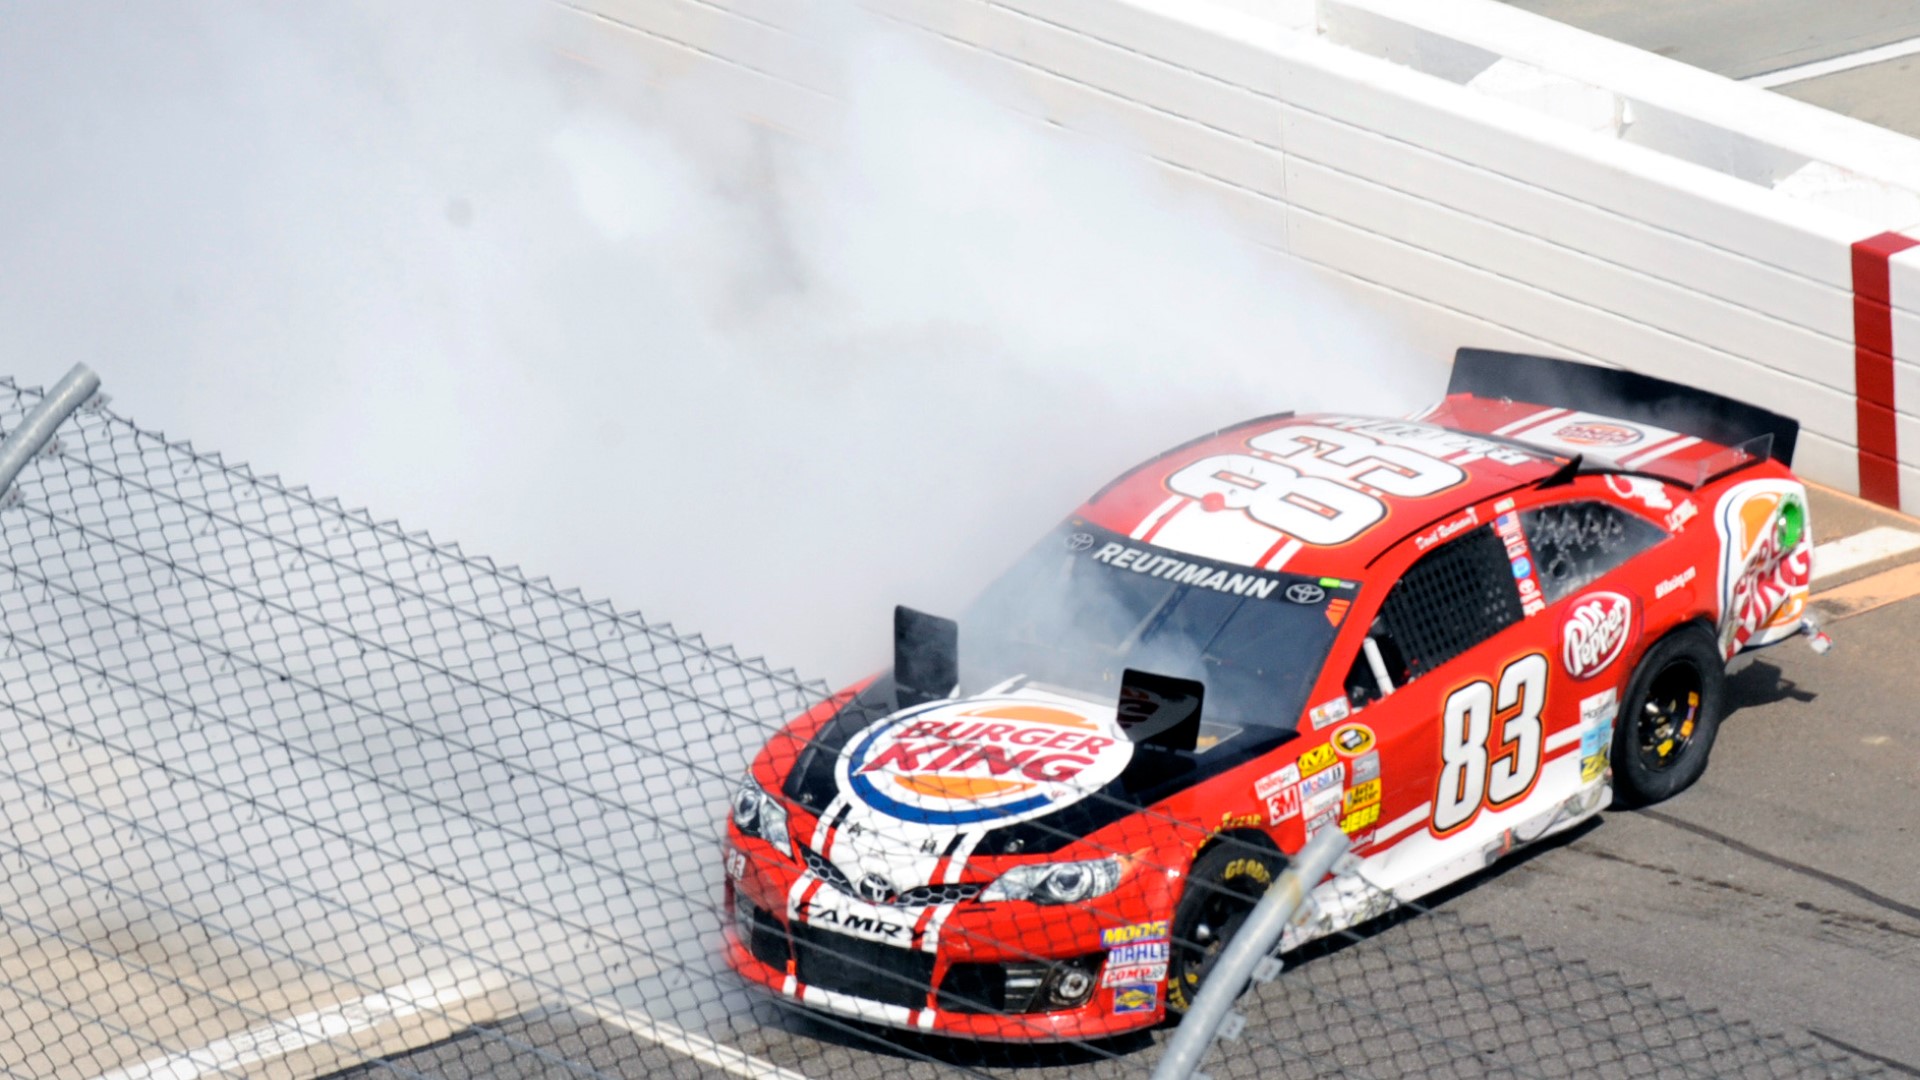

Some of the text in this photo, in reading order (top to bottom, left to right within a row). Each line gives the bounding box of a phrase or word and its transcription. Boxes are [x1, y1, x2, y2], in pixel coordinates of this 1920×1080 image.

[1165, 424, 1468, 546] 83
[1093, 541, 1279, 599] REUTIMANN
[1573, 600, 1606, 635] Dr
[1563, 600, 1625, 677] Pepper
[894, 720, 1115, 756] BURGER
[1433, 653, 1549, 833] 83
[860, 741, 1095, 783] KING
[1271, 787, 1298, 820] 3M
[1339, 803, 1381, 834] JEGS
[795, 902, 927, 941] CAMRY
[1111, 943, 1169, 964] MAHLE
